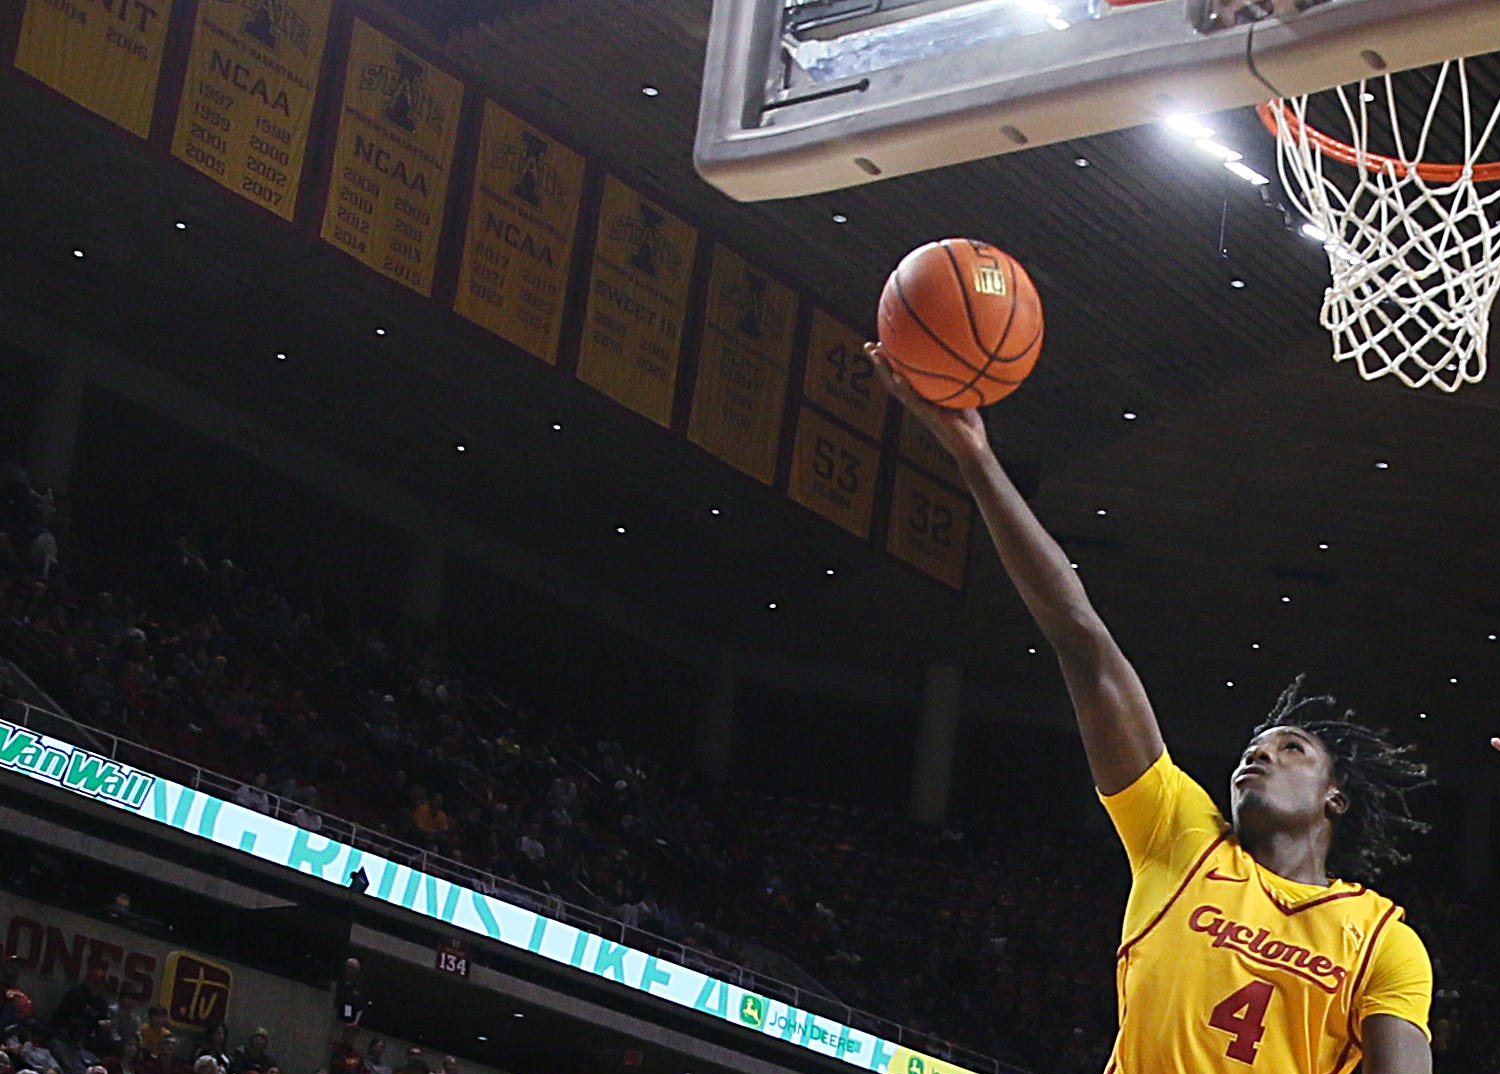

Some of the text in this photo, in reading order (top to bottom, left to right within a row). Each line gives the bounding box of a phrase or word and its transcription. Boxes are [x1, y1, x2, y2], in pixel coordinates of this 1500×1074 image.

[210, 48, 290, 117] NCAA
[193, 101, 231, 132] 1999
[184, 142, 284, 207] 2005 2007
[188, 122, 288, 188] 2001 2002
[353, 134, 428, 198] NCAA
[485, 211, 554, 268] NCAA
[597, 280, 657, 328] SWEET
[826, 342, 876, 398] 42
[812, 436, 860, 494] 53
[909, 489, 953, 546] 32
[5, 916, 157, 1003] ONES
[438, 951, 468, 977] 134
[1189, 904, 1349, 992] Cyclones
[769, 1011, 857, 1054] JOHN DEERE
[1207, 979, 1276, 1066] 4
